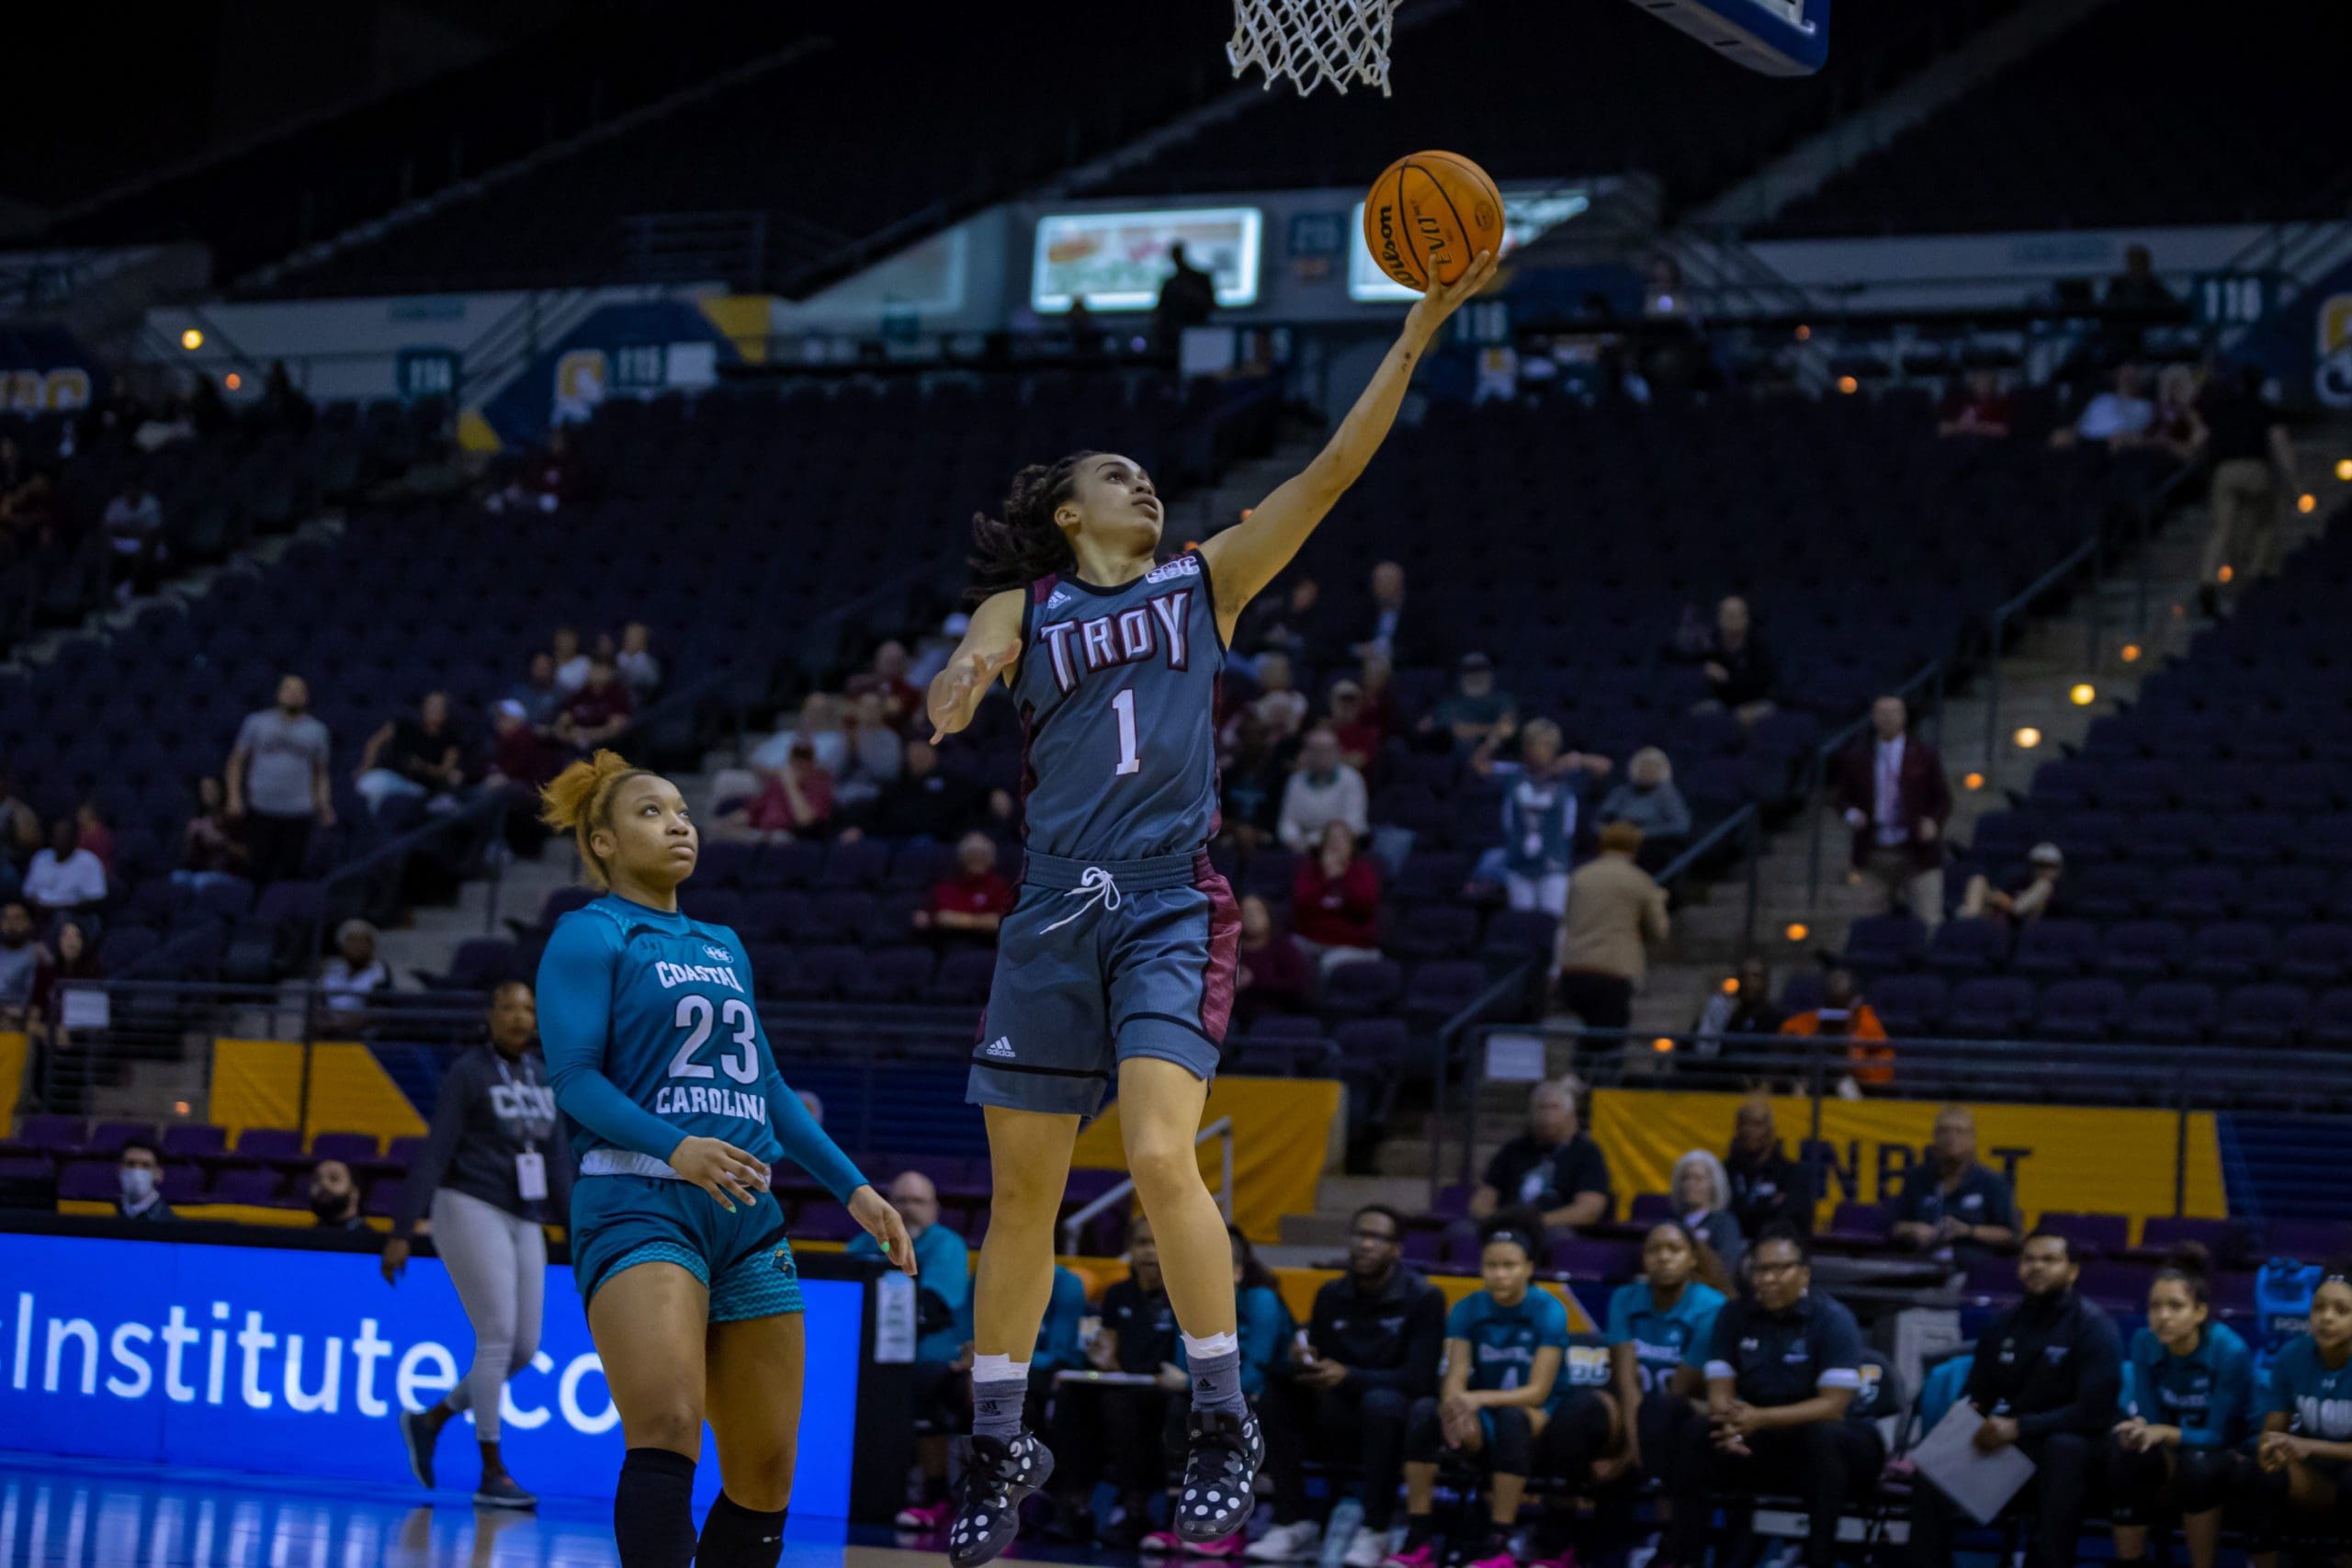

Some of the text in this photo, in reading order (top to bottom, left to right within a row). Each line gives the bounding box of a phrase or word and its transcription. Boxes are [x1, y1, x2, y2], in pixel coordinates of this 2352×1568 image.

[1380, 206, 1420, 287] Wilson
[1037, 588, 1193, 698] TROY
[1111, 688, 1141, 776] 1
[655, 961, 745, 994] COASTAL
[667, 994, 761, 1085] 23
[986, 1048, 1016, 1058] adidas
